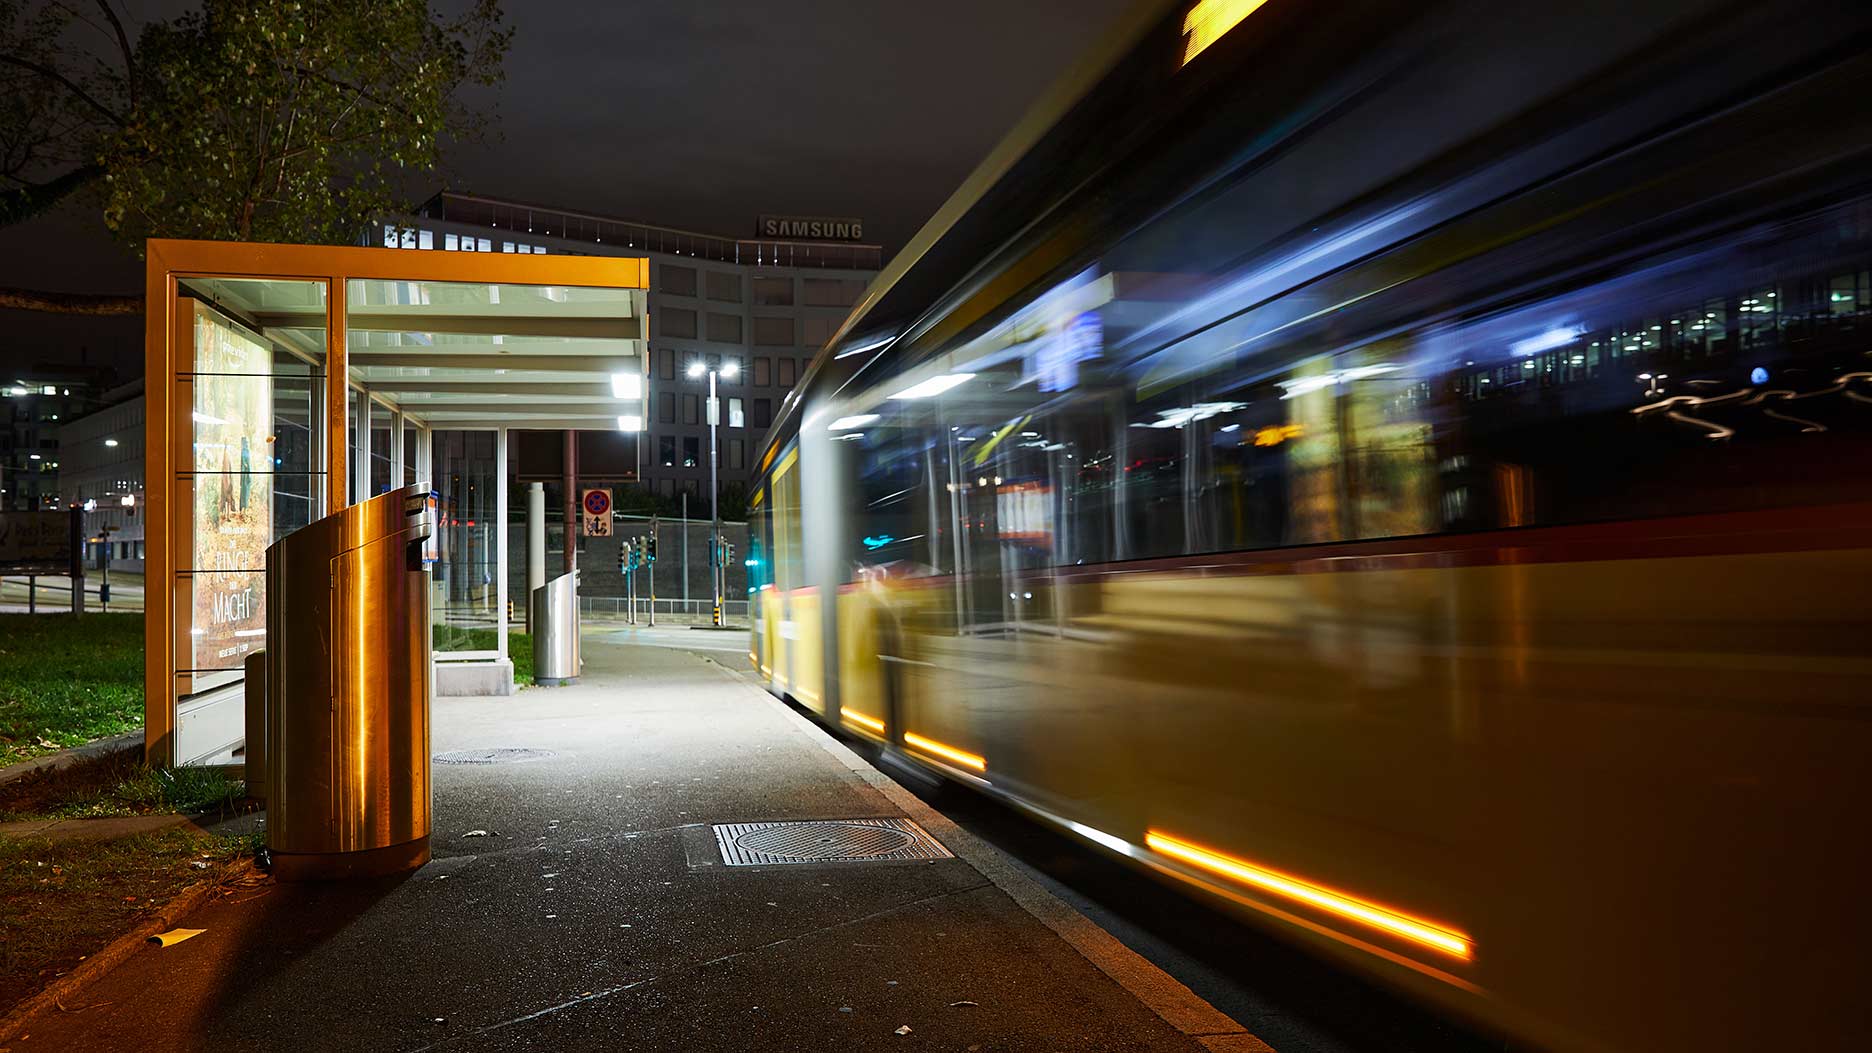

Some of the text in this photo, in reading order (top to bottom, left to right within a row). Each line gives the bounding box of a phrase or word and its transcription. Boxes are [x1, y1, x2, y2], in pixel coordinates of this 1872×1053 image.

[766, 220, 863, 239] SAMSUNG
[216, 551, 250, 583] RINGE
[213, 588, 252, 625] MACHT
